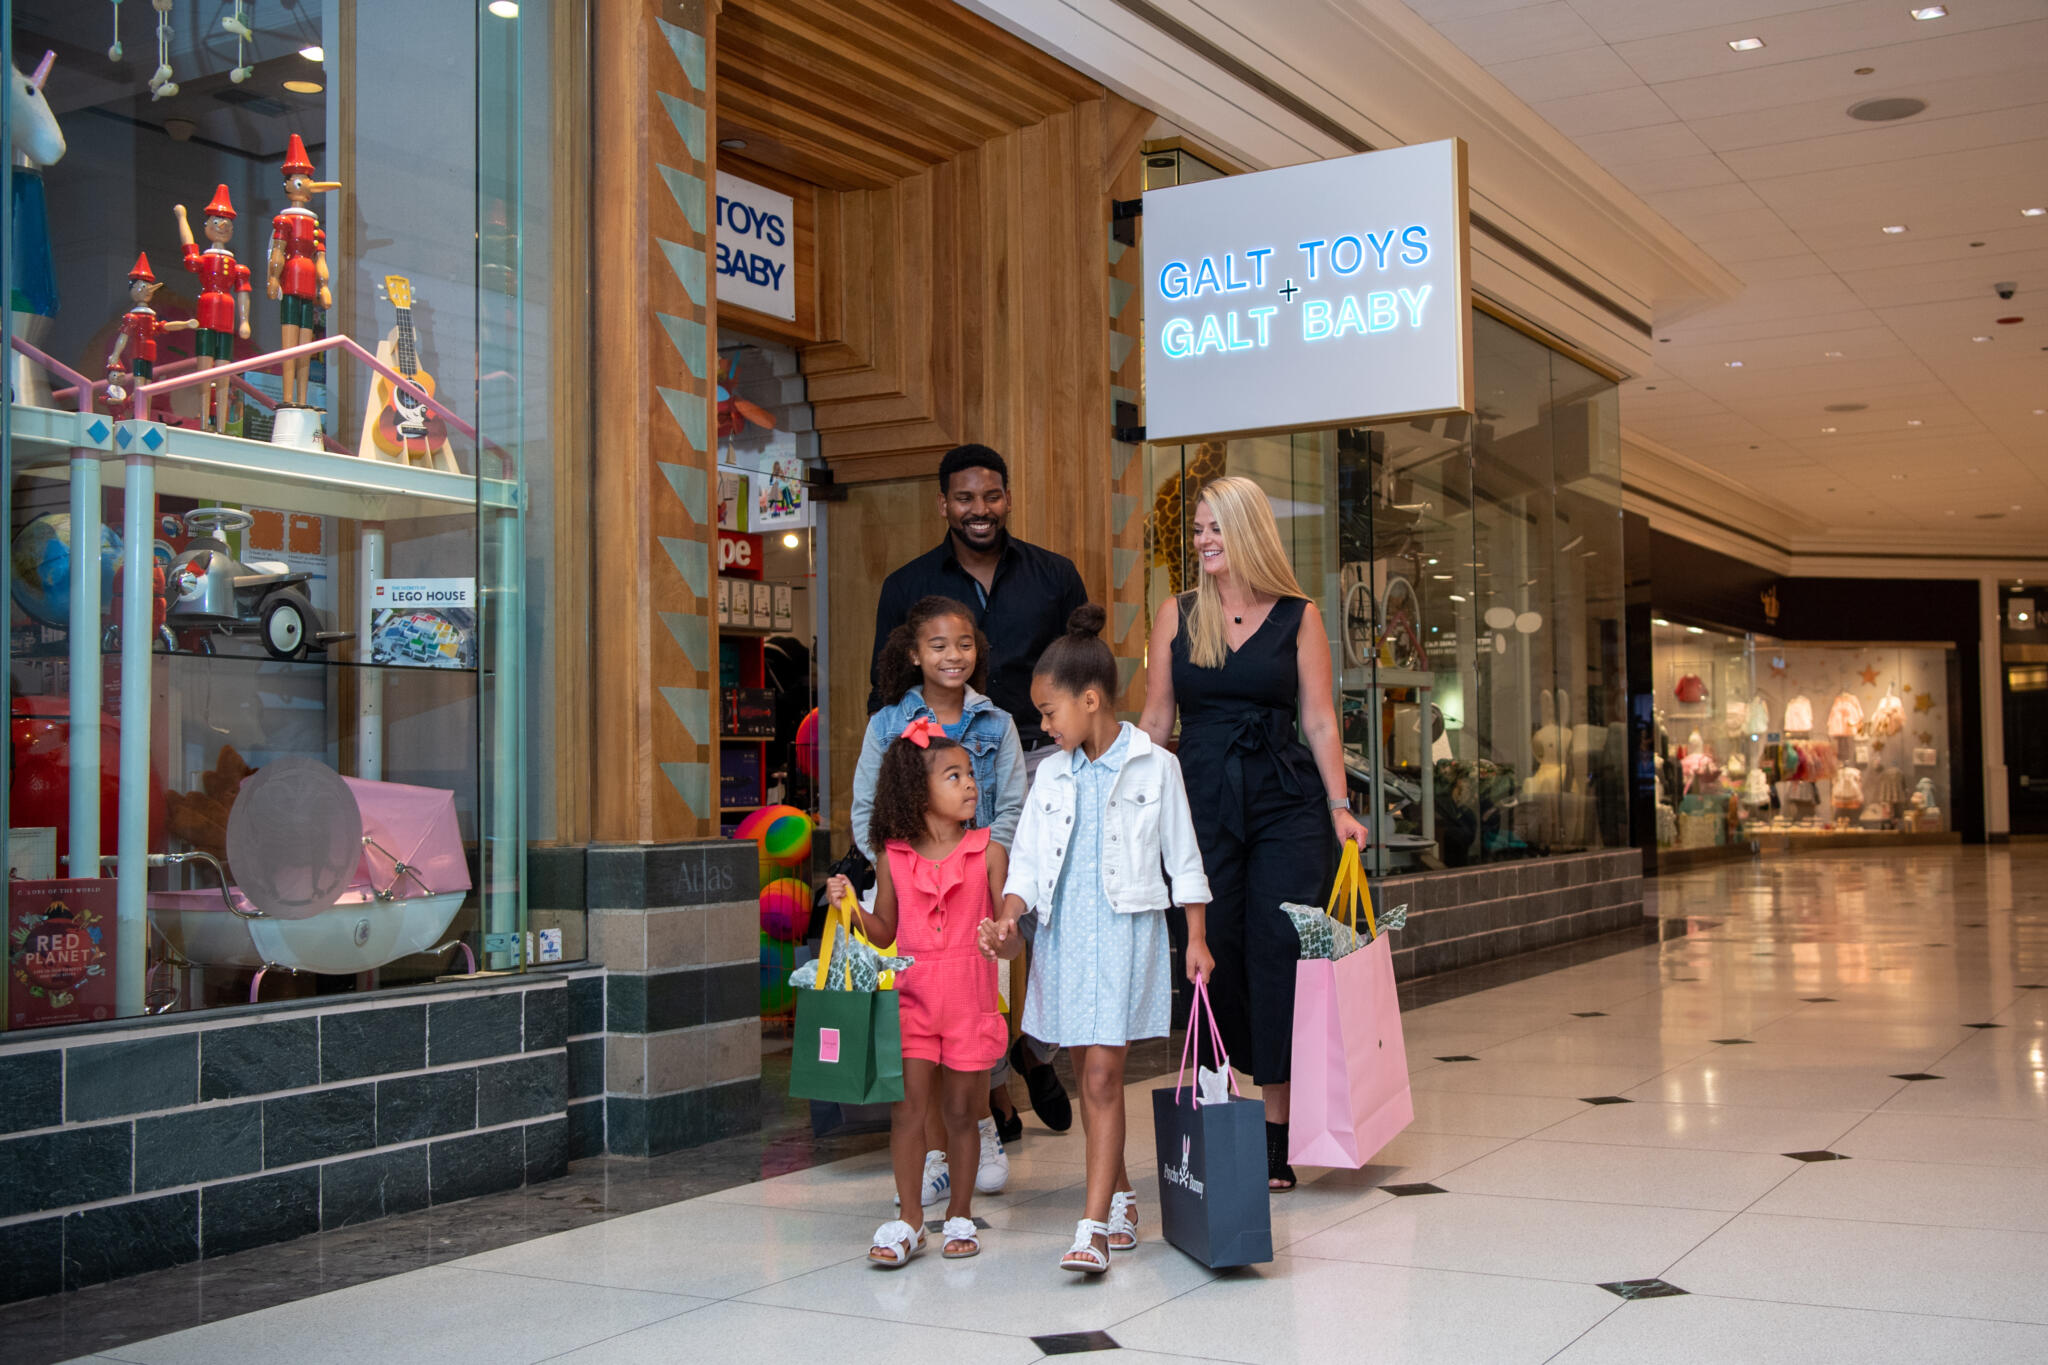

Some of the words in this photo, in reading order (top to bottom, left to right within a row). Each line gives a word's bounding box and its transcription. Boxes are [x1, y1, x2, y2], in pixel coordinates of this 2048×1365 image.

[716, 195, 785, 247] TOYS
[716, 242, 786, 291] BABY
[1159, 247, 1273, 300] GALT
[1299, 225, 1430, 279] TOYS
[1161, 306, 1278, 358] GALT
[1302, 284, 1432, 341] BABY
[392, 592, 422, 601] LEGO
[426, 591, 466, 601] HOUSE
[26, 950, 90, 965] PLANET
[37, 934, 79, 951] RED
